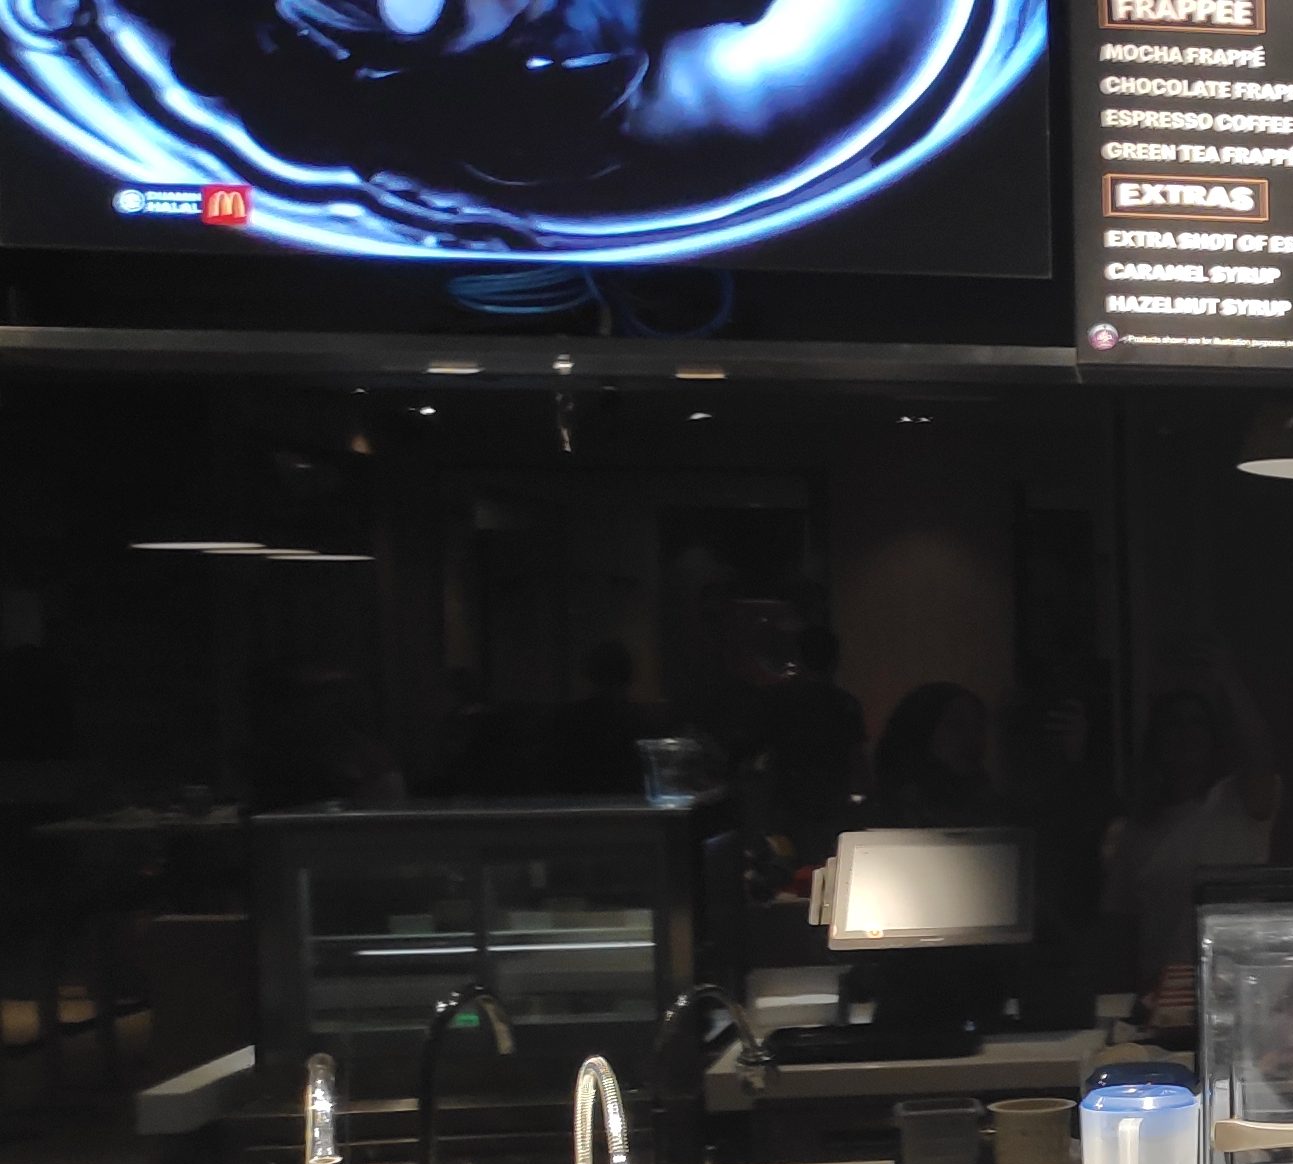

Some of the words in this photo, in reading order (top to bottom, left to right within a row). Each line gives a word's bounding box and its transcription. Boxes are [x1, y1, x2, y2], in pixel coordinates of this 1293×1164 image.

[1100, 43, 1183, 65] MOCHA
[1184, 46, 1266, 68] FRAPPÉ
[1100, 76, 1231, 98] CHOCOLATE
[1100, 109, 1213, 131] ESPRESSO
[1100, 141, 1176, 161] GREEN
[1177, 145, 1220, 163] TEA
[1115, 183, 1254, 211] EXTRAS
[1104, 230, 1177, 250] EXTRA
[1177, 232, 1237, 251] SHOT
[1236, 234, 1268, 252] OF
[1105, 262, 1209, 283] CARAMEL
[1209, 265, 1281, 285] SYRUP
[1106, 295, 1220, 316] HAZELNUT
[1219, 298, 1292, 317] SYRUP
